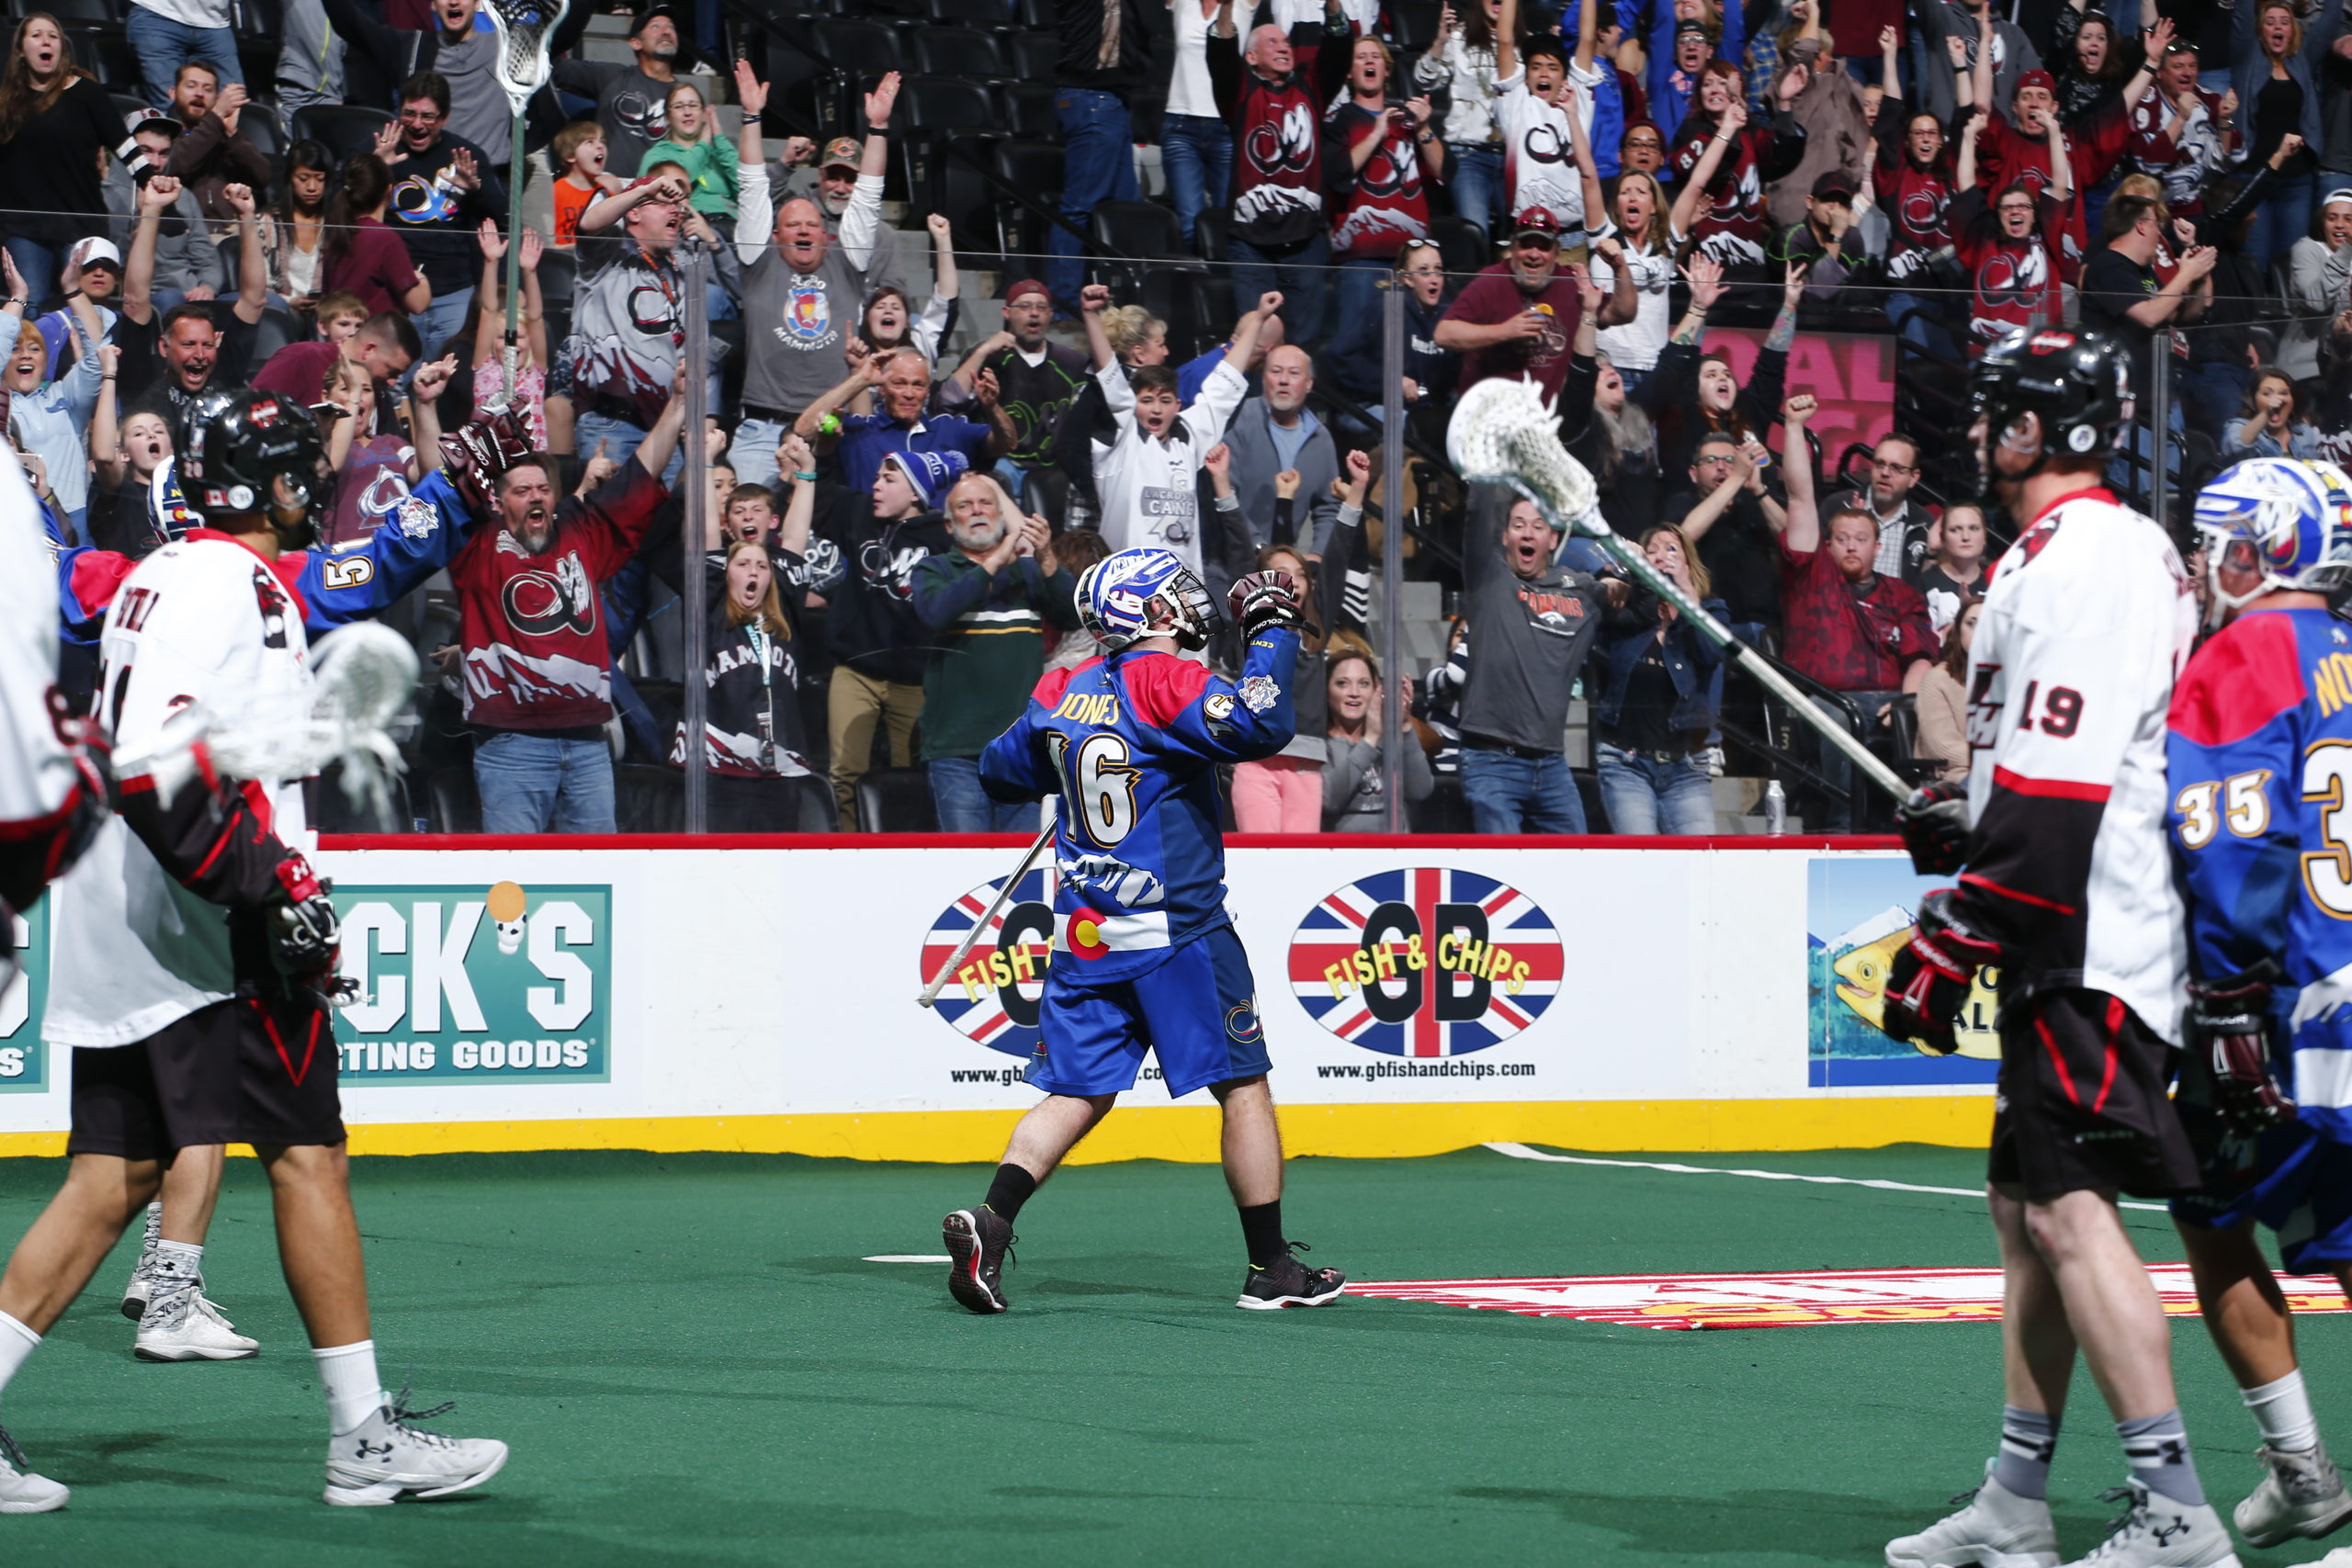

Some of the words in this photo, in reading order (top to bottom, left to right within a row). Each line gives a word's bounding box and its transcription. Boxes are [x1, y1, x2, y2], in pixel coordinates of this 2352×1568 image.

[774, 327, 839, 351] MAMMOTH
[1050, 693, 1120, 726] JONES
[2018, 680, 2085, 739] 19
[2312, 650, 2352, 719] NO
[1046, 731, 1144, 850] 16
[2175, 768, 2274, 851] 35
[2301, 738, 2352, 922] 3
[339, 882, 594, 1033] CK'S
[957, 940, 1036, 1004] FISH
[1323, 940, 1398, 1001] FISH
[1406, 933, 1429, 971] &
[1438, 932, 1532, 996] CHIPS
[1360, 899, 1493, 1026] GB
[452, 1039, 589, 1069] GOODS
[1317, 1061, 1536, 1082] www.gbfishandchips.com
